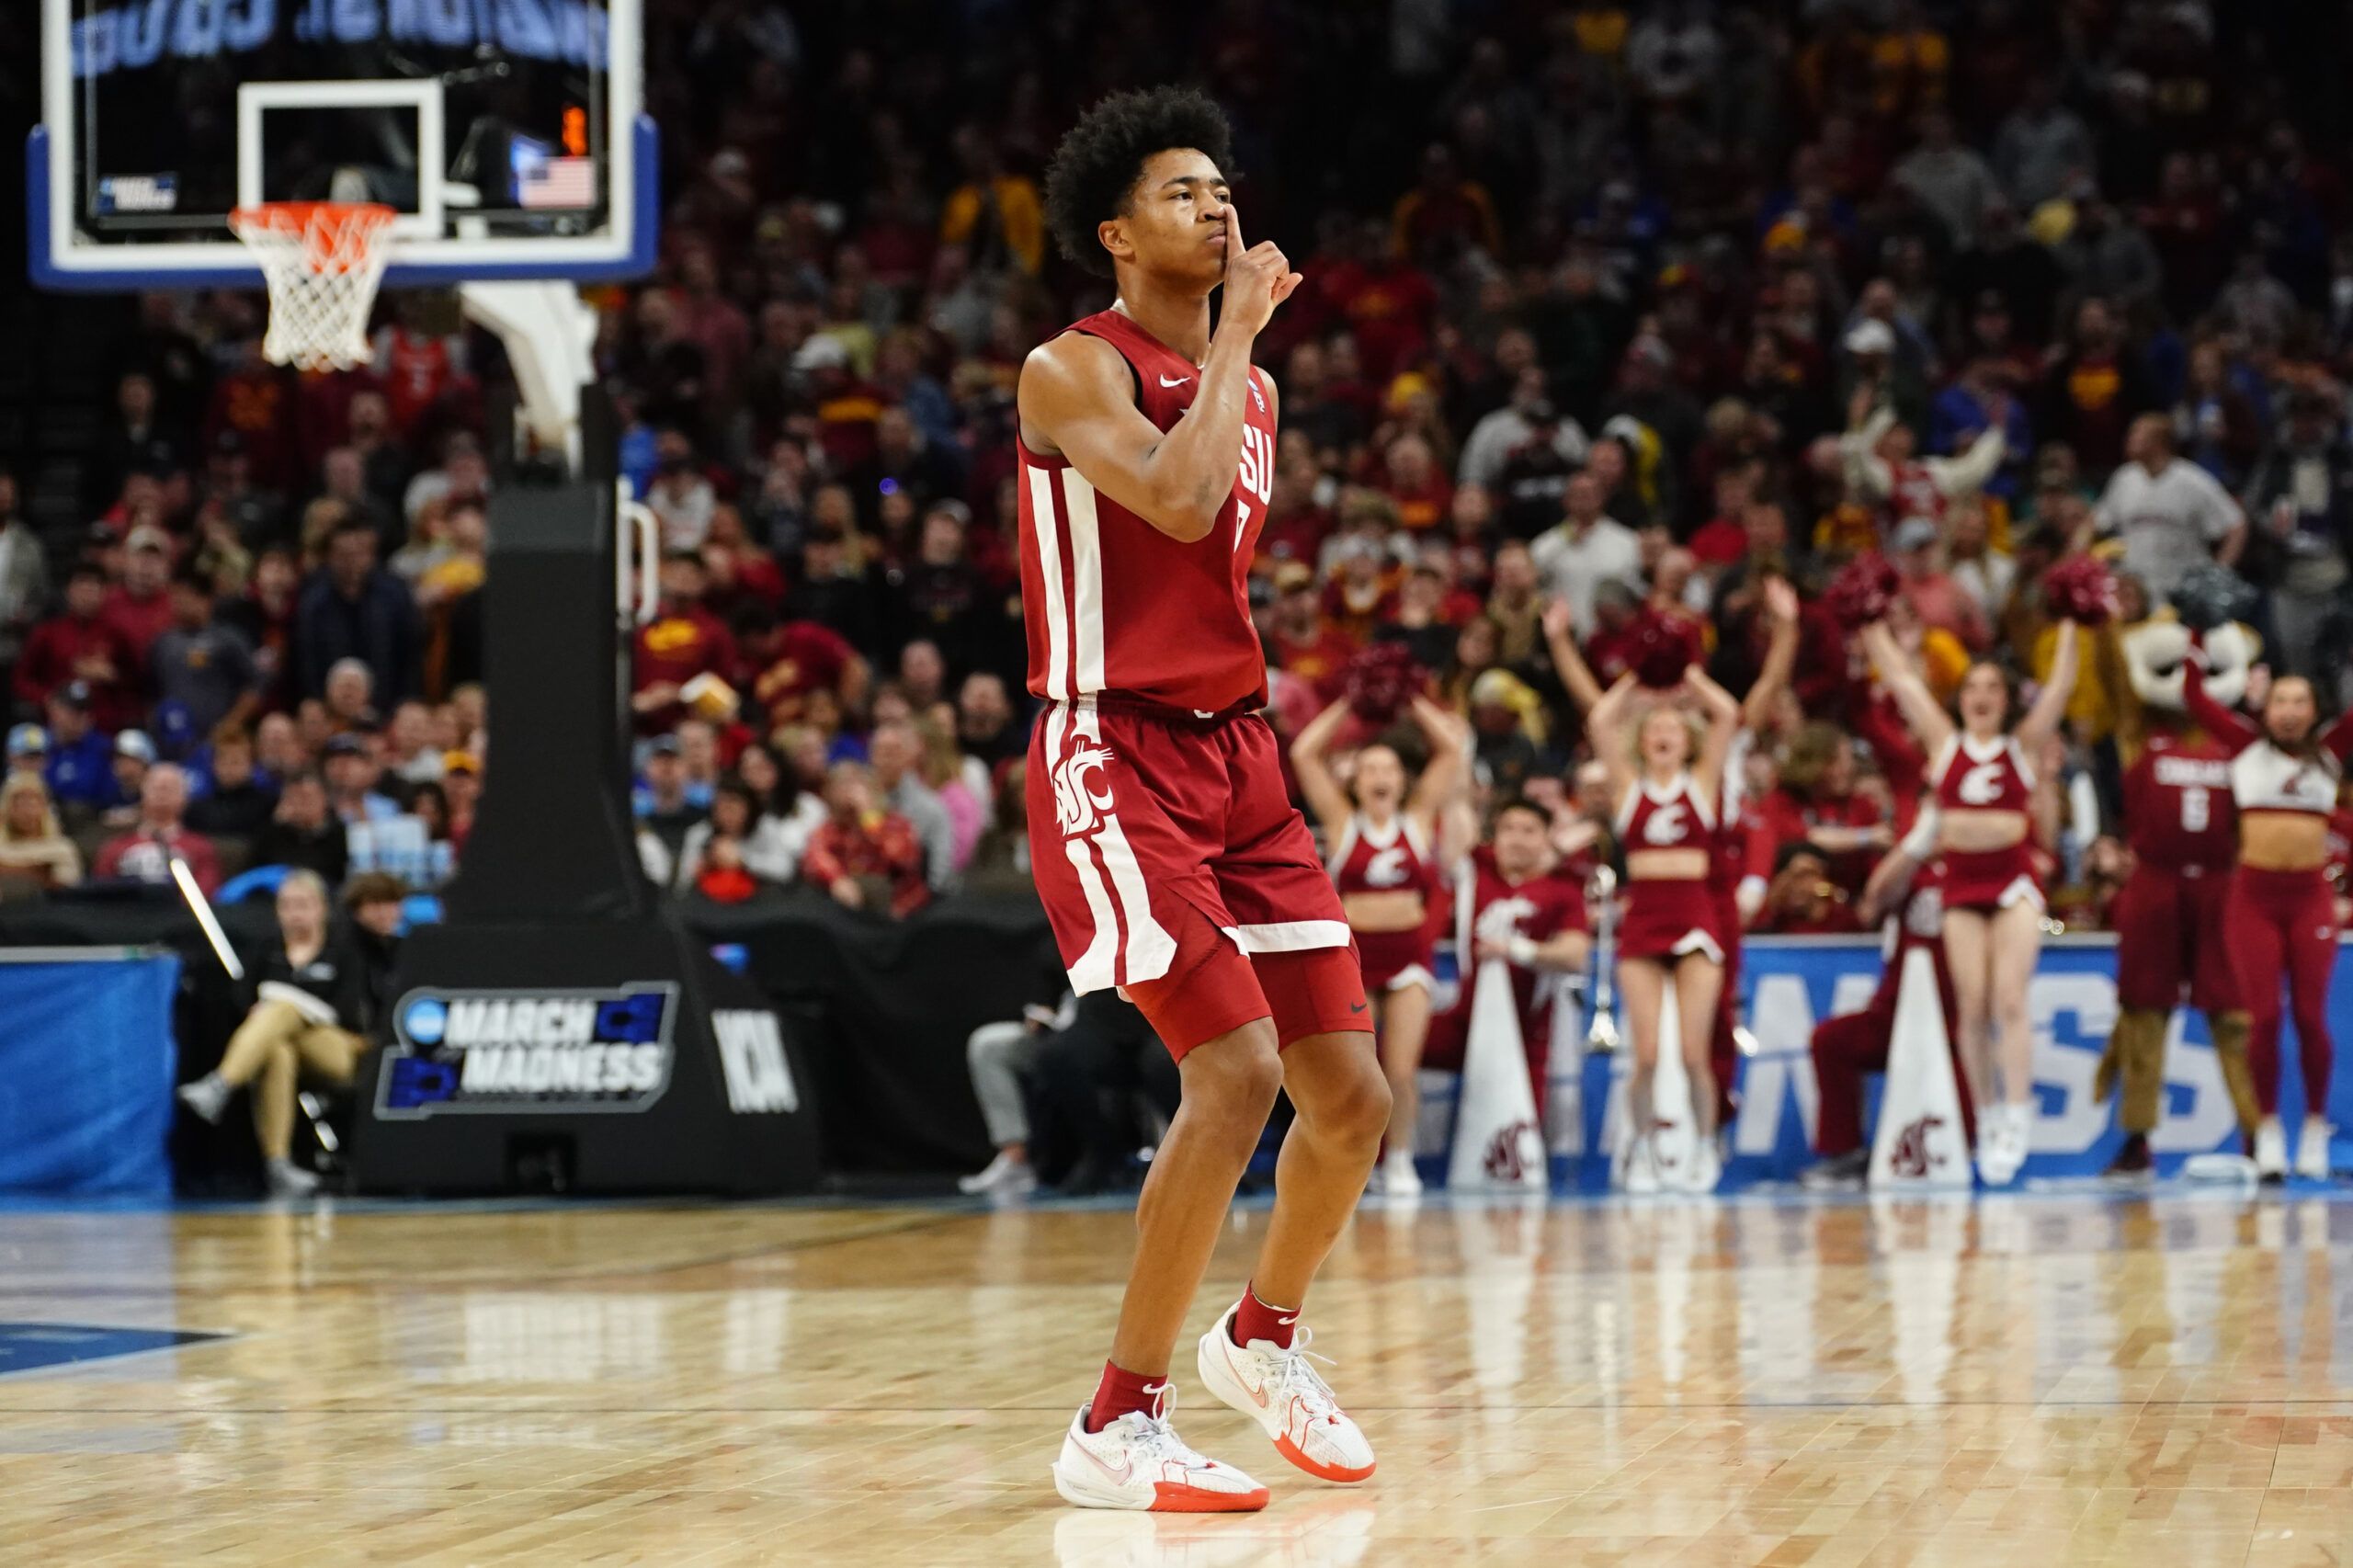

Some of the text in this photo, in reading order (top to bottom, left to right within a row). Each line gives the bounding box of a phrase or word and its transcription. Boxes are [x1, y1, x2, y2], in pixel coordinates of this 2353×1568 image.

[1238, 423, 1273, 506] SU
[445, 997, 597, 1049] MARCH
[460, 1042, 662, 1093] MADNESS
